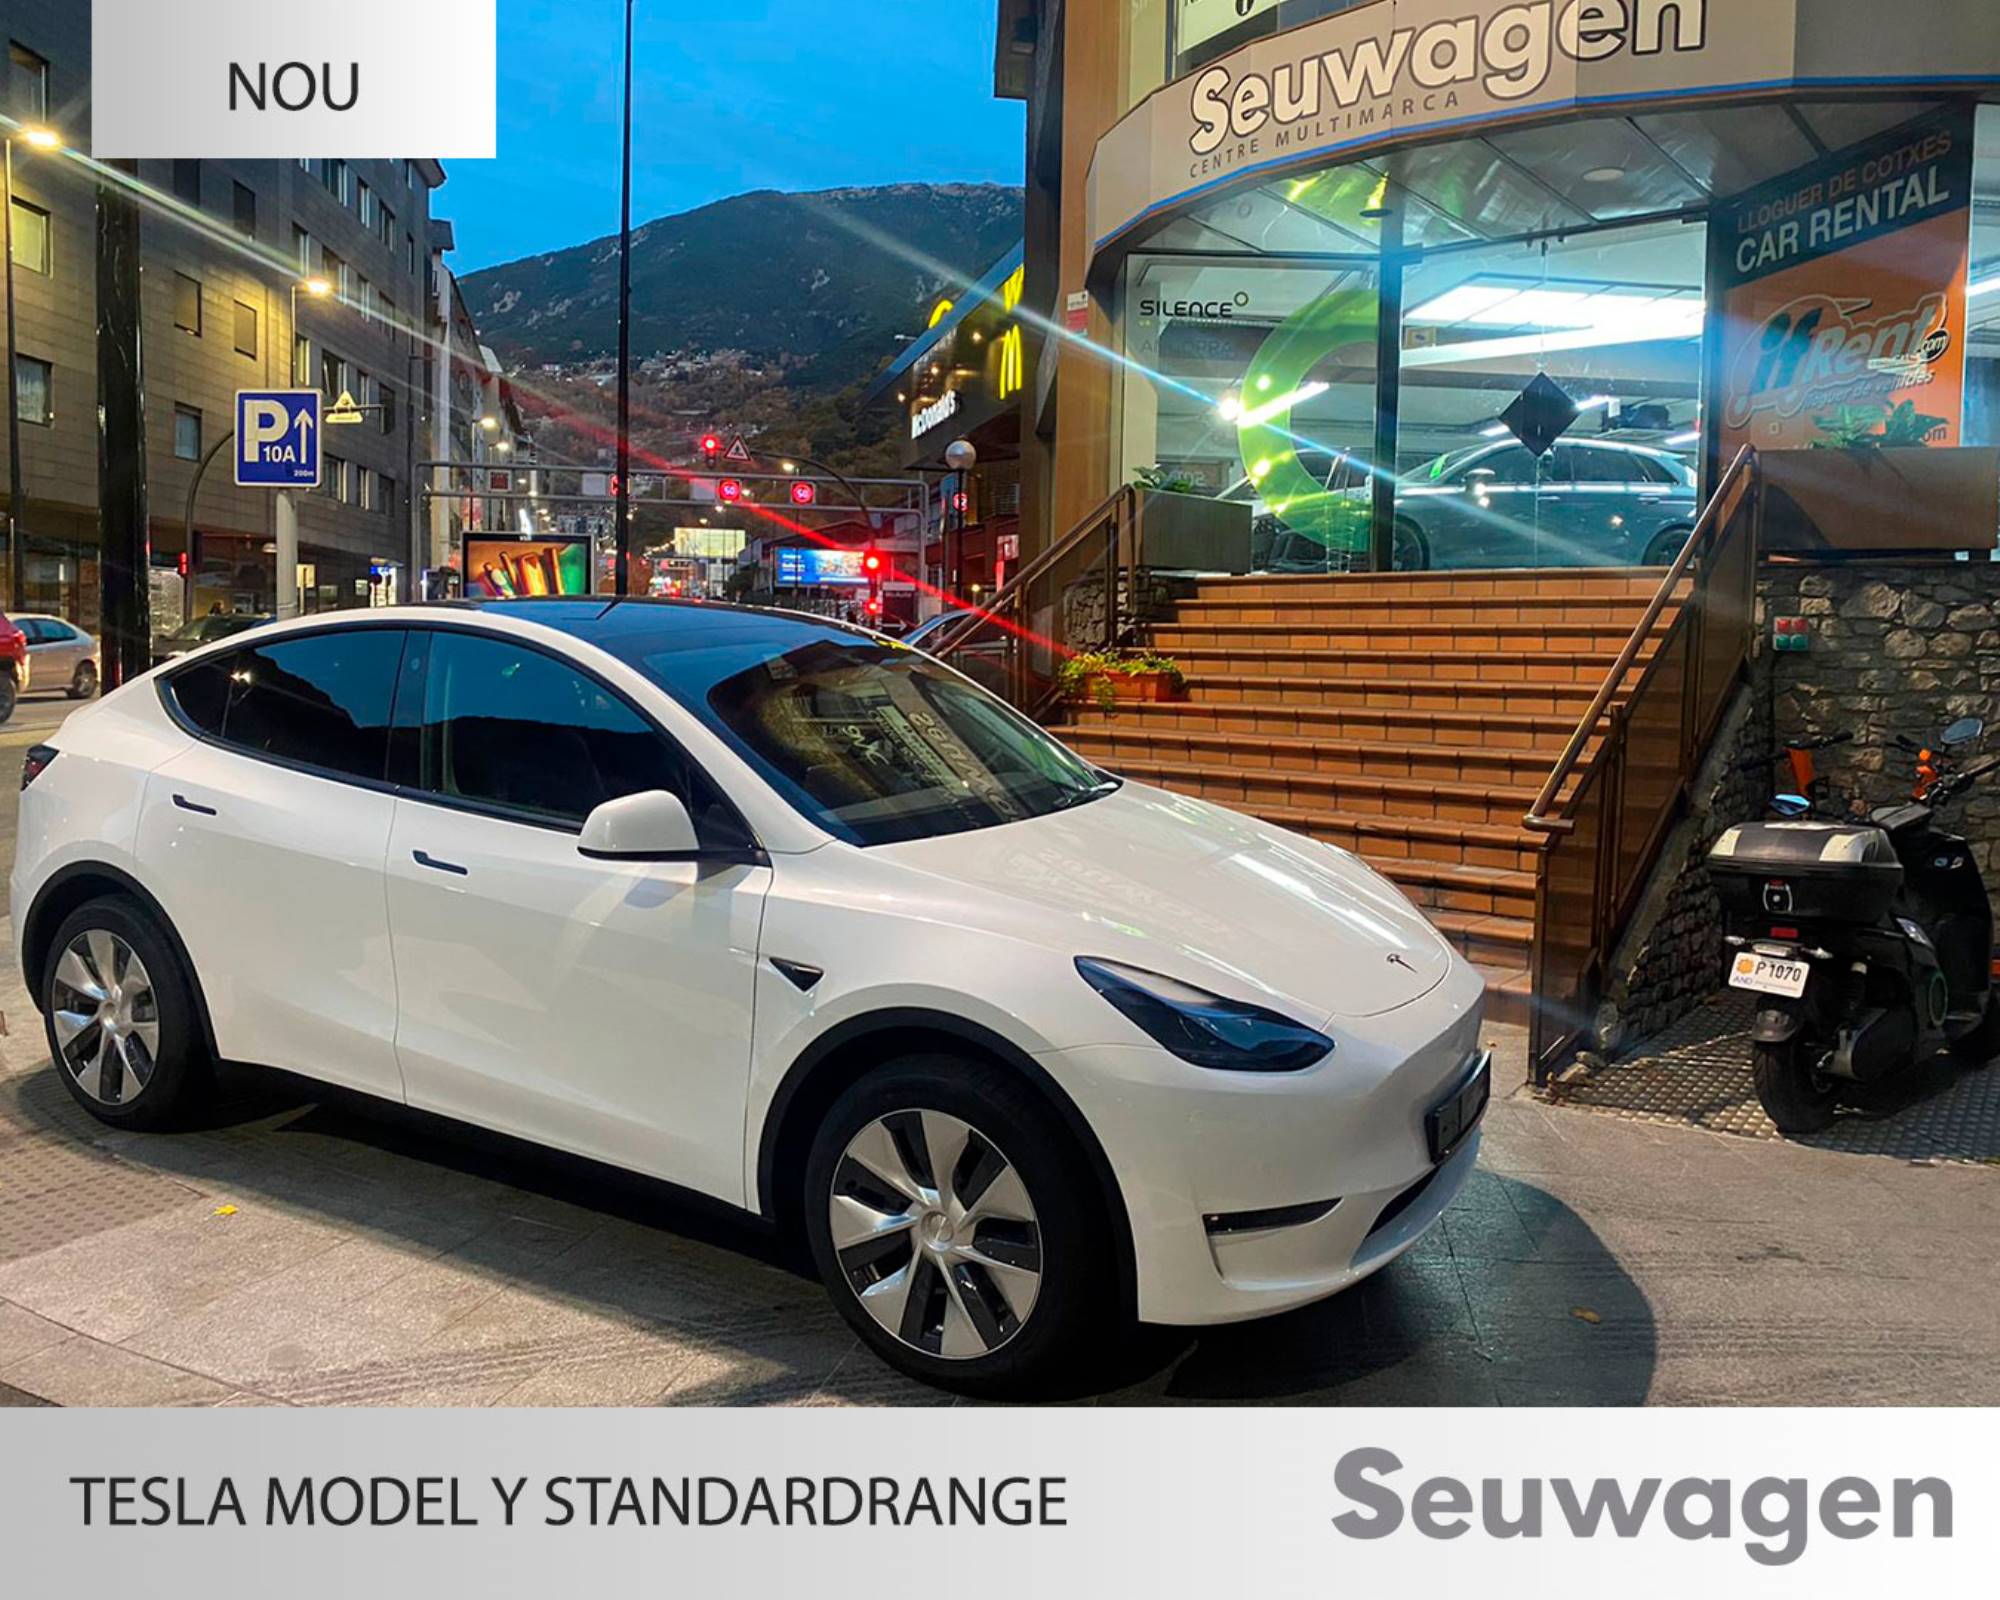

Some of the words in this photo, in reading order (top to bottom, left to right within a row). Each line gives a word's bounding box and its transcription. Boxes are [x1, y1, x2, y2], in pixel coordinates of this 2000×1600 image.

[1189, 0, 1705, 155] Seuwagen
[1190, 139, 1259, 178] CENTRE
[1275, 91, 1459, 147] MULTIMARCA
[1736, 220, 1799, 273] CAR
[1809, 165, 1949, 247] RENTAL
[1738, 183, 1823, 233] LLOGUER
[1828, 168, 1856, 197] DE
[1862, 130, 1952, 183] COTXES
[1140, 300, 1233, 318] SILENCE
[244, 400, 289, 462] P
[263, 445, 296, 462] 10A
